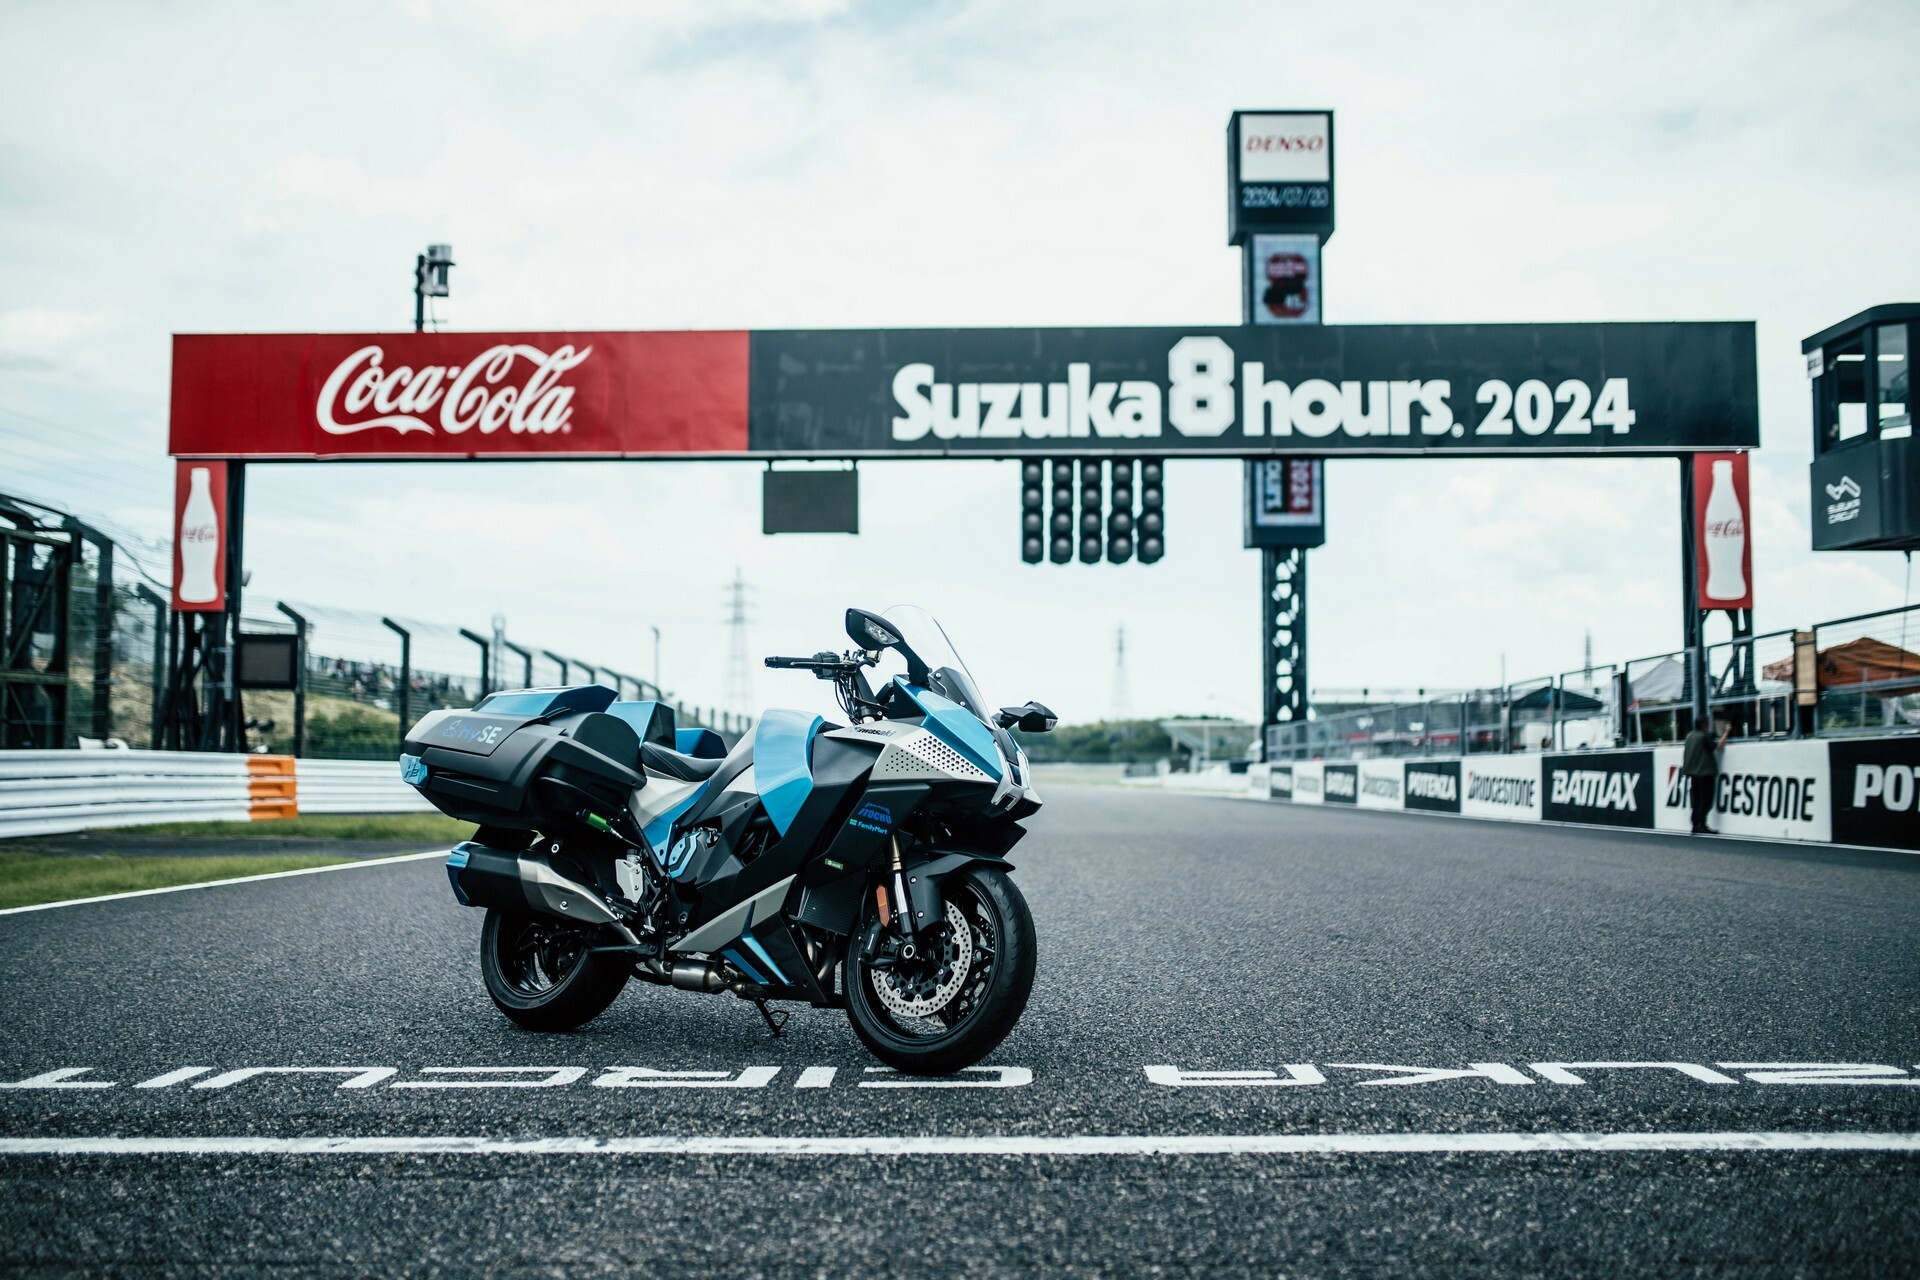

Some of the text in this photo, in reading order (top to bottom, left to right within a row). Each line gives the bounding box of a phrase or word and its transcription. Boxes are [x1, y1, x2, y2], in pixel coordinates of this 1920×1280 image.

[1246, 135, 1324, 153] DENSO
[316, 344, 592, 435] Coca-Cola
[892, 363, 1162, 441] Suzuka
[1168, 336, 1235, 437] 8
[1475, 377, 1635, 435] 2024
[1468, 770, 1536, 807] BRIDGESTONE
[1666, 765, 1816, 821] BRGESTONE
[857, 821, 888, 834] FamilyMart
[858, 805, 892, 824] ITOCHU
[1144, 1061, 1920, 1086] ZUKA
